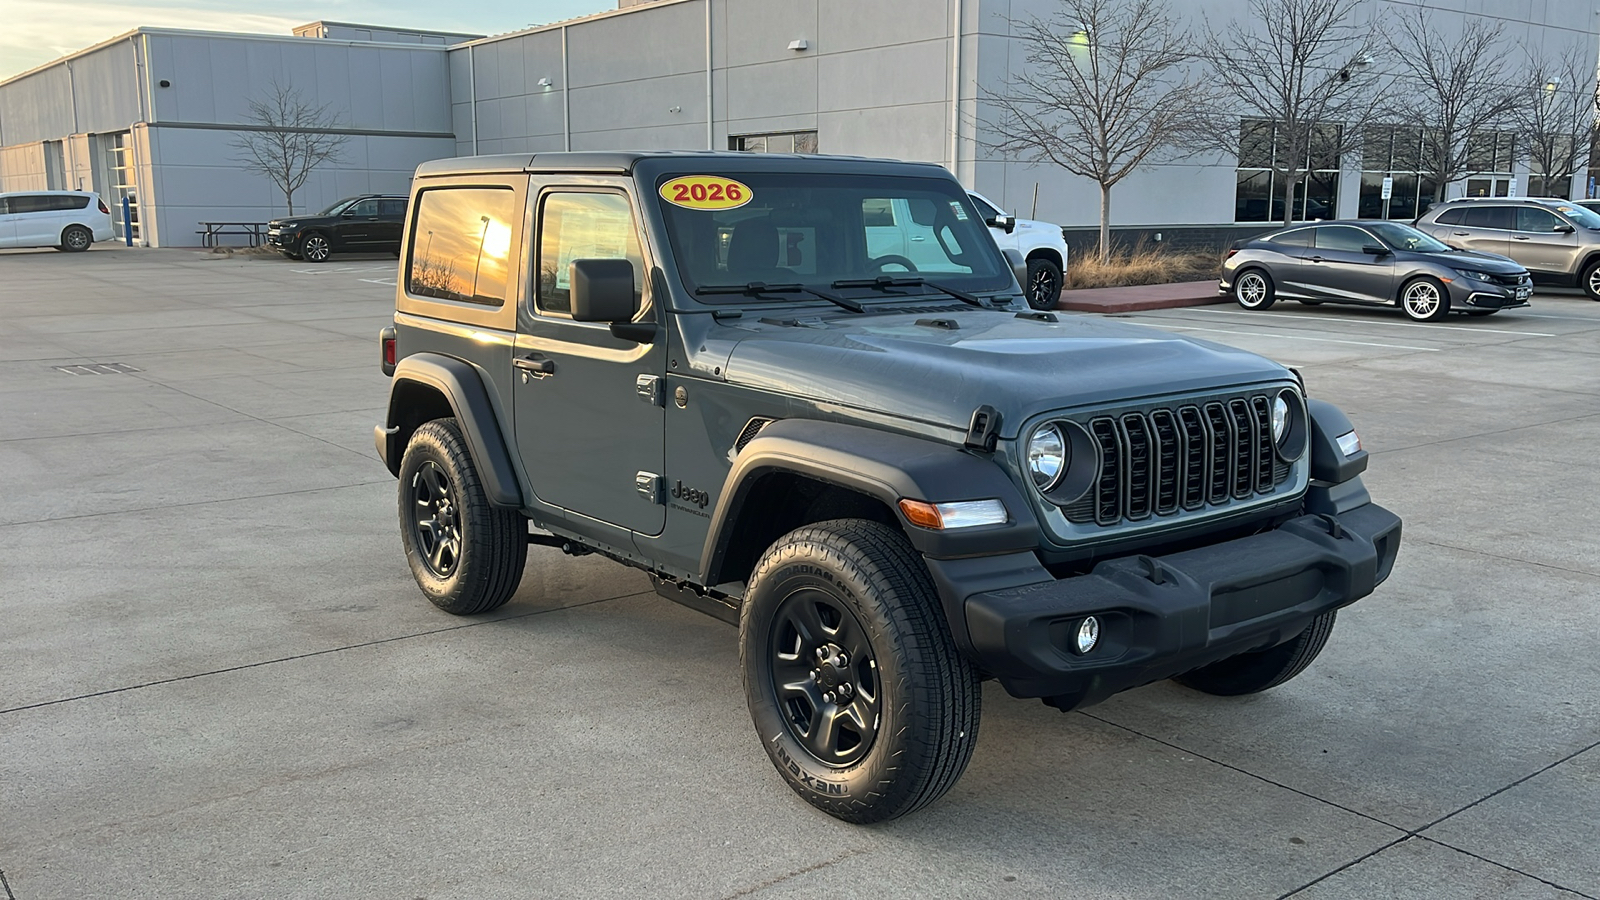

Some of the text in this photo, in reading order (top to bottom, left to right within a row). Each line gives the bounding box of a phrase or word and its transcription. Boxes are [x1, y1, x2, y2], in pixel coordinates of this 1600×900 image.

[672, 183, 742, 202] 2026
[671, 479, 709, 509] Jeep
[777, 746, 842, 794] NEXEN
